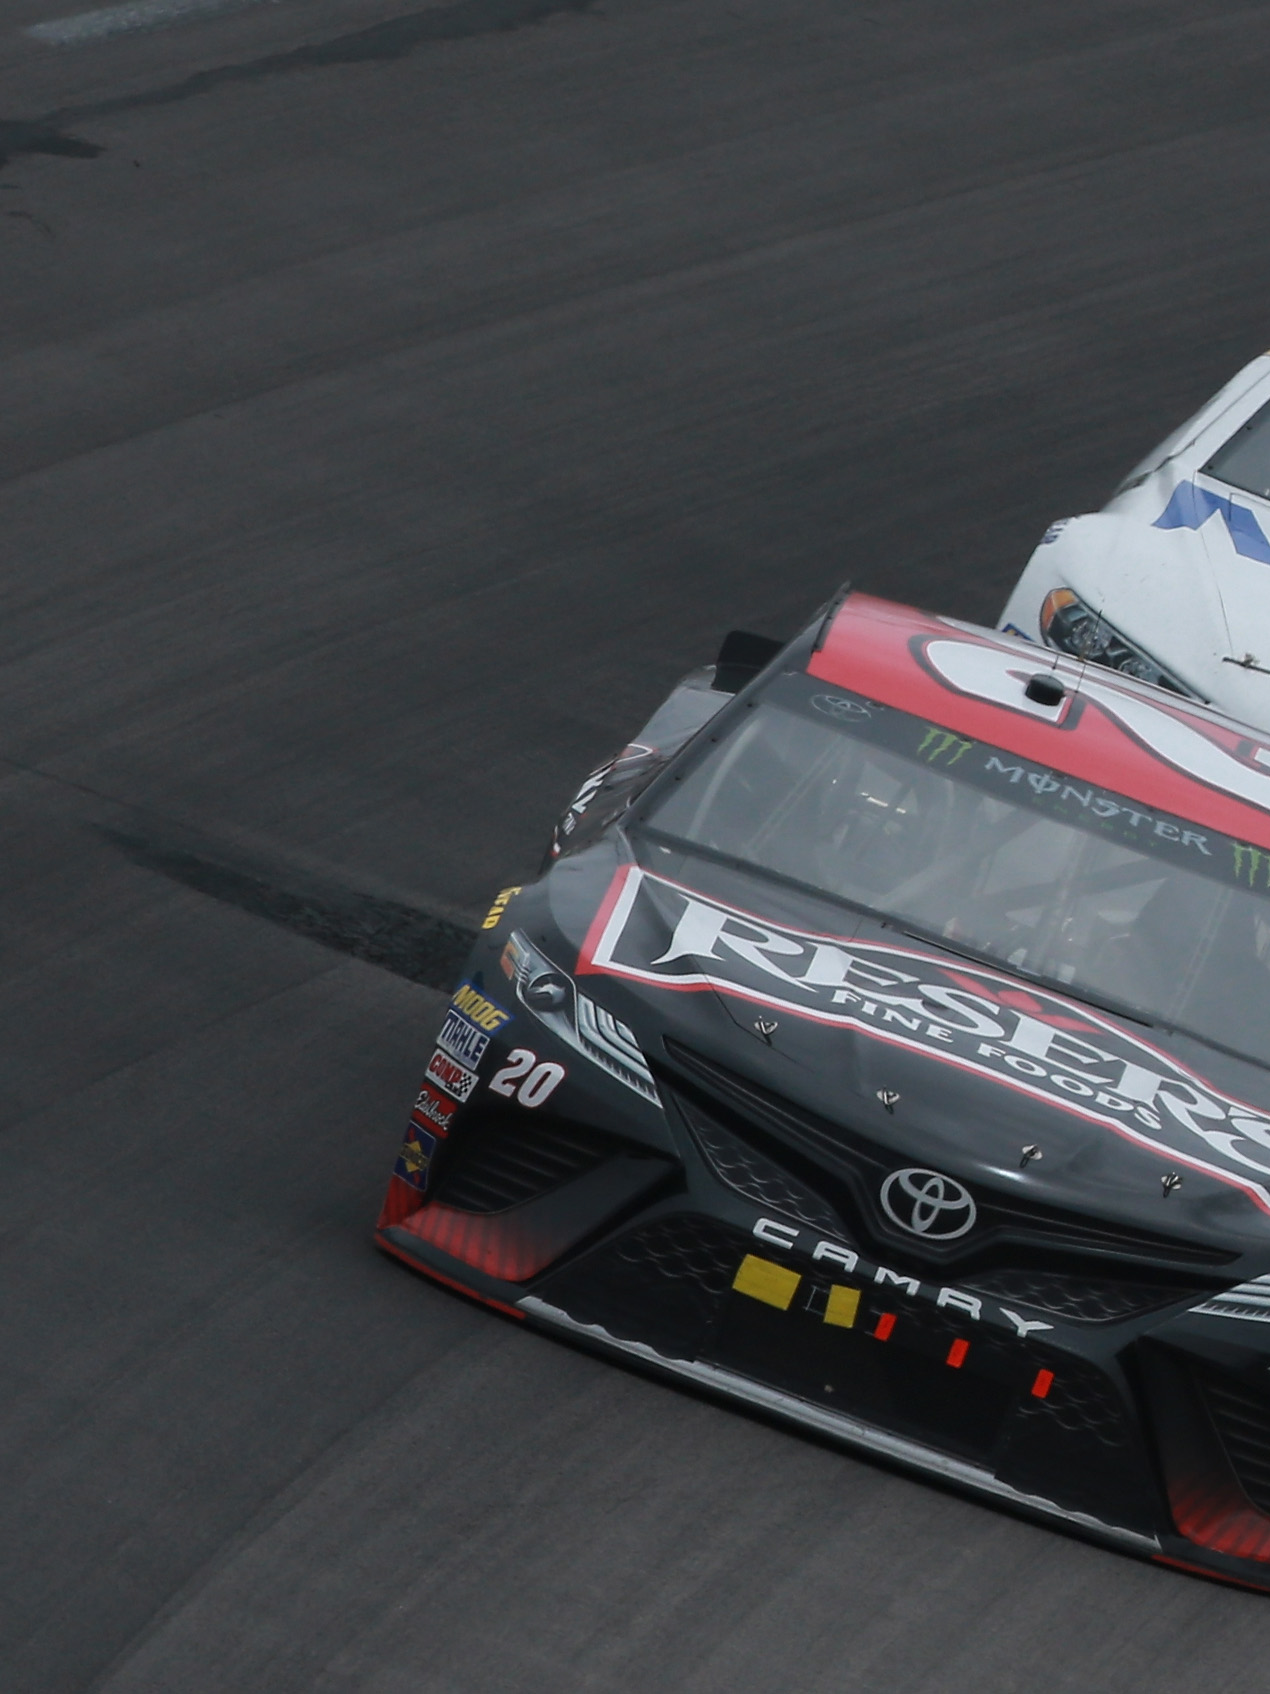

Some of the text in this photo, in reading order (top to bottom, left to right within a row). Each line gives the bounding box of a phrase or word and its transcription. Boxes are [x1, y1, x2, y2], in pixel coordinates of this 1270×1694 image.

[452, 983, 510, 1031] MOOG
[441, 1016, 487, 1063] MAHLE
[831, 989, 1163, 1131] FINE FOODS
[428, 1053, 463, 1084] COMP
[488, 1047, 567, 1109] 20
[752, 1216, 1055, 1338] CAMRY
